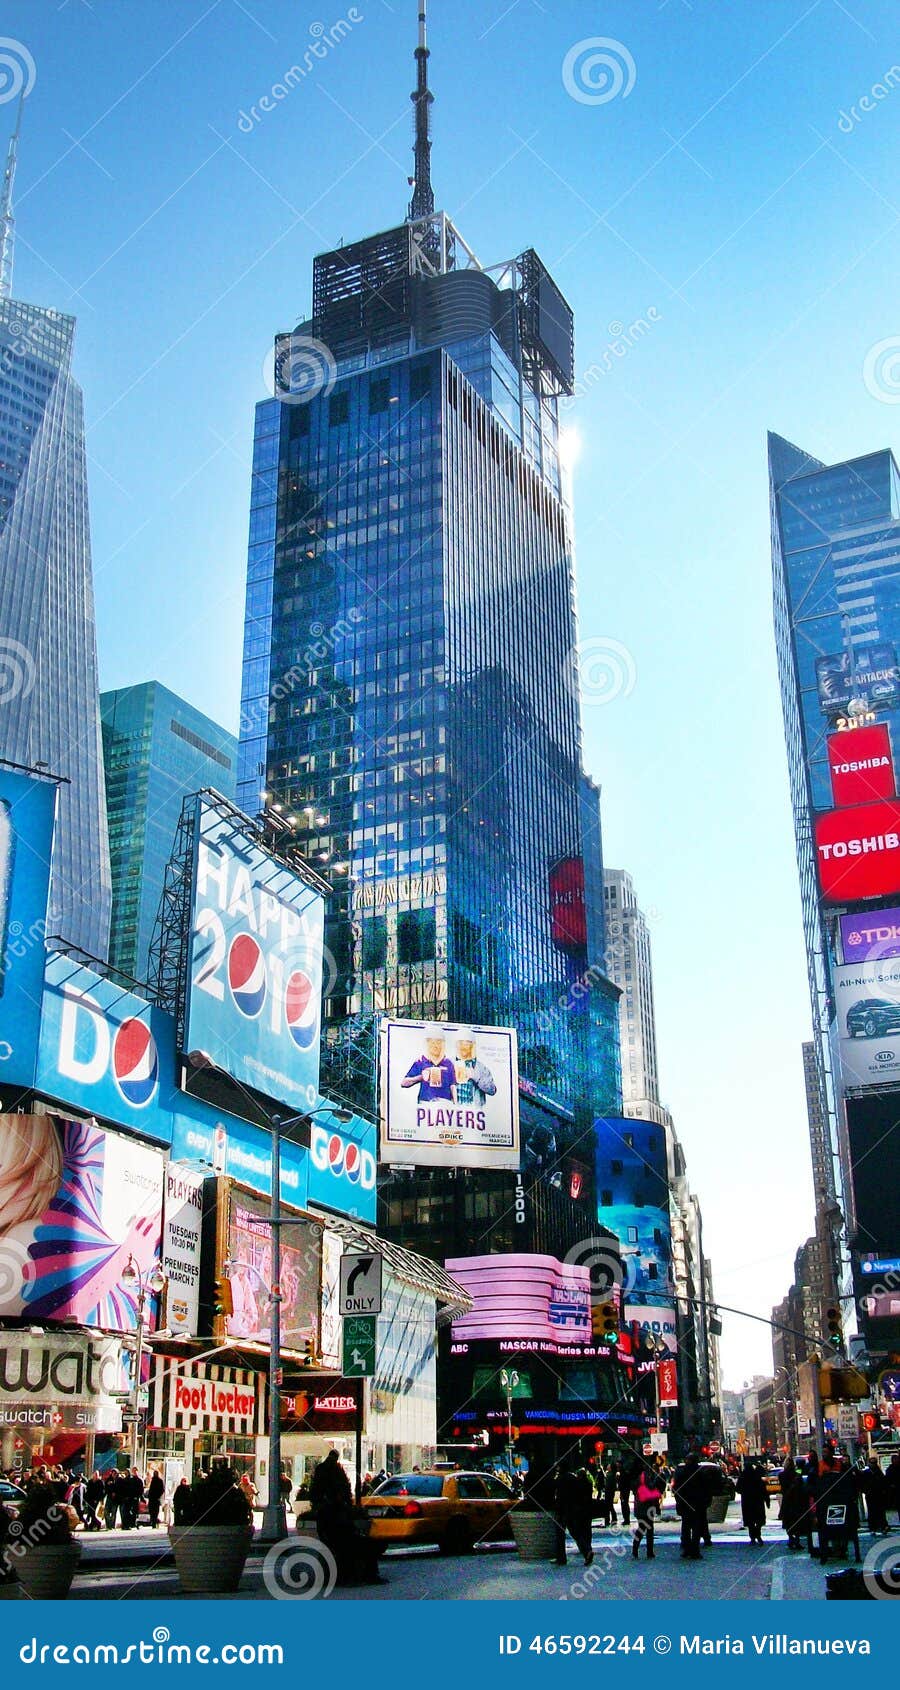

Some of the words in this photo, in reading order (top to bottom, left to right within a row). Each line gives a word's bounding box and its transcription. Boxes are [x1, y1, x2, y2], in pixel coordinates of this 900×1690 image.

[833, 756, 889, 774] TOSHIBA
[199, 838, 323, 960] HAPPY
[877, 1053, 893, 1062] KIA
[416, 1108, 486, 1131] PLAYERS
[309, 1123, 376, 1190] GOOD
[167, 1176, 202, 1210] PLAYERS
[169, 1222, 199, 1242] TUESDAYS
[186, 1240, 196, 1252] PM
[164, 1257, 200, 1276] PREMIERES
[168, 1270, 190, 1285] MARCH
[190, 1275, 195, 1286] 2
[171, 1303, 189, 1316] SPIKE
[345, 1298, 375, 1310] ONLY
[451, 1343, 469, 1354] ABC
[500, 1341, 538, 1351] NASCAR
[583, 1346, 596, 1355] on
[597, 1345, 611, 1356] ABC
[175, 1378, 206, 1410] Foot
[211, 1380, 255, 1416] Locker
